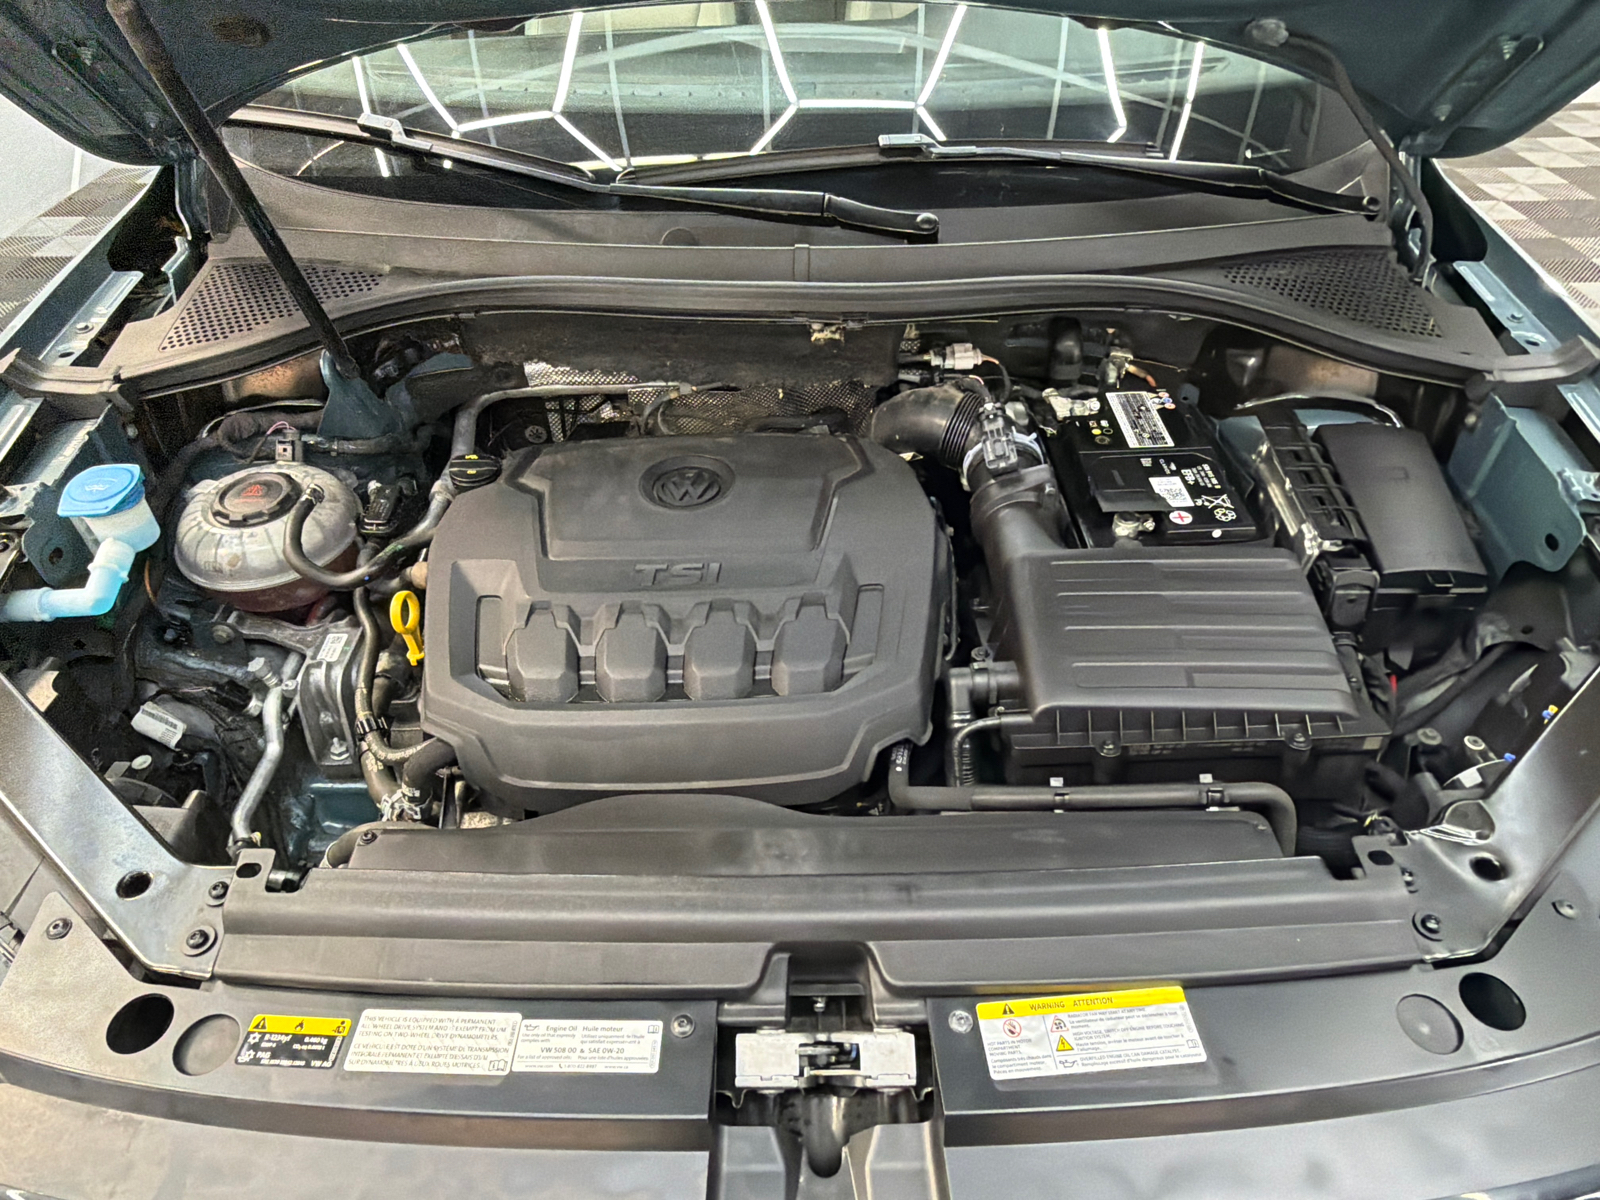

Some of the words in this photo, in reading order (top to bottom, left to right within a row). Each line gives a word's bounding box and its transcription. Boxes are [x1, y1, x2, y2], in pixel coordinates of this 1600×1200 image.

[634, 562, 722, 587] TSI
[1029, 1001, 1065, 1011] WARNING
[1073, 997, 1113, 1007] ATTENTION
